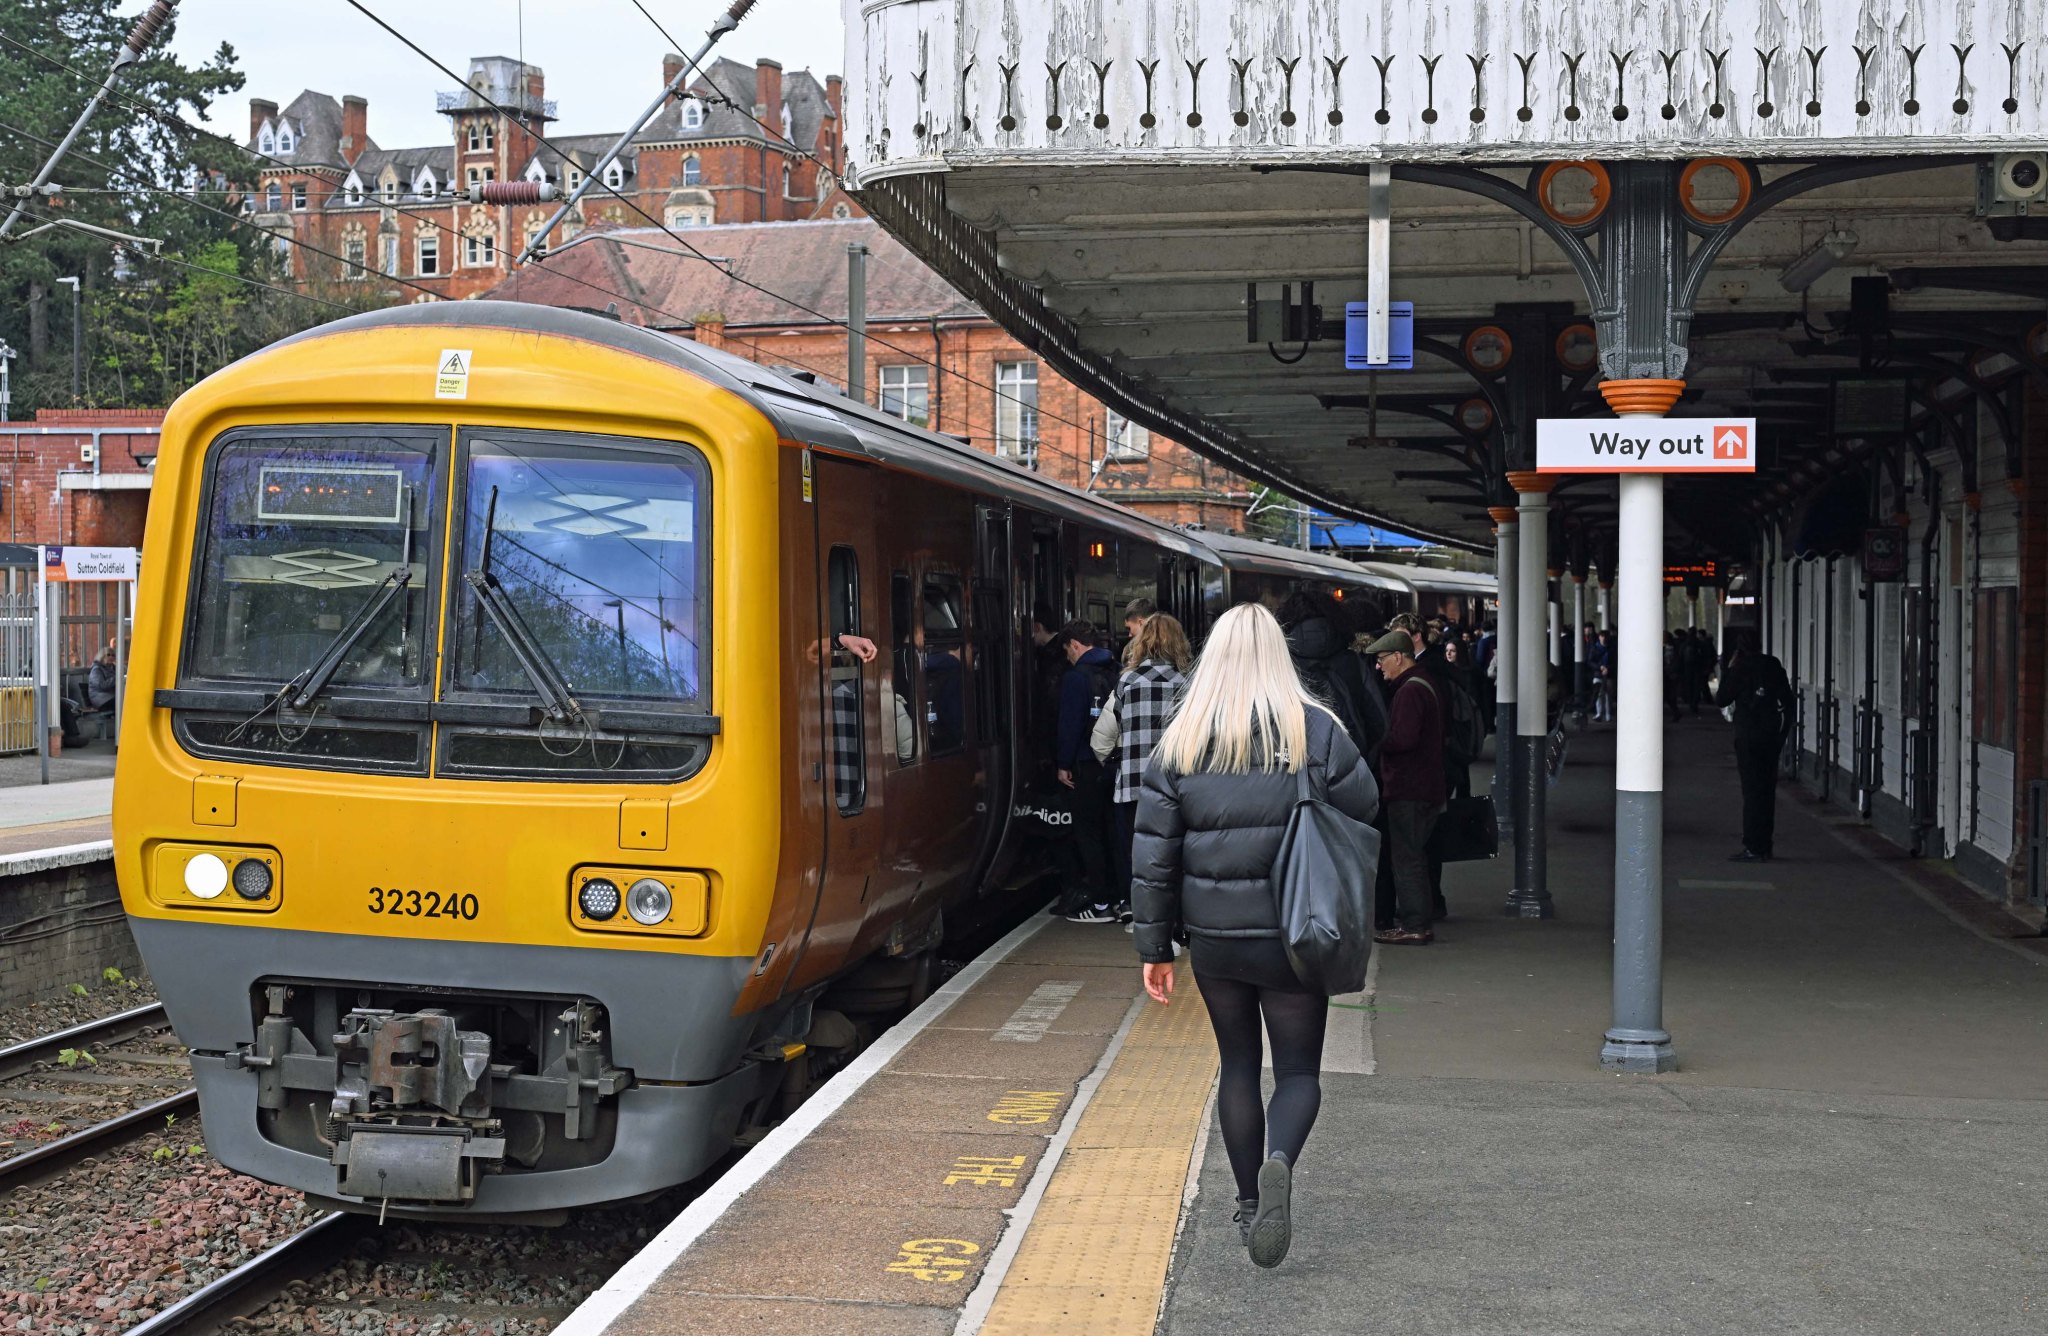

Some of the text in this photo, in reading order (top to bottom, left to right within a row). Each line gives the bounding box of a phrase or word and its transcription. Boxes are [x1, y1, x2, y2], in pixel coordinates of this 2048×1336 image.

[1589, 432, 1704, 460] Way out
[77, 562, 97, 574] Sutton
[98, 562, 125, 574] Coldfield
[367, 886, 479, 920] 323240
[884, 1090, 1066, 1282] MIND THE GAP
